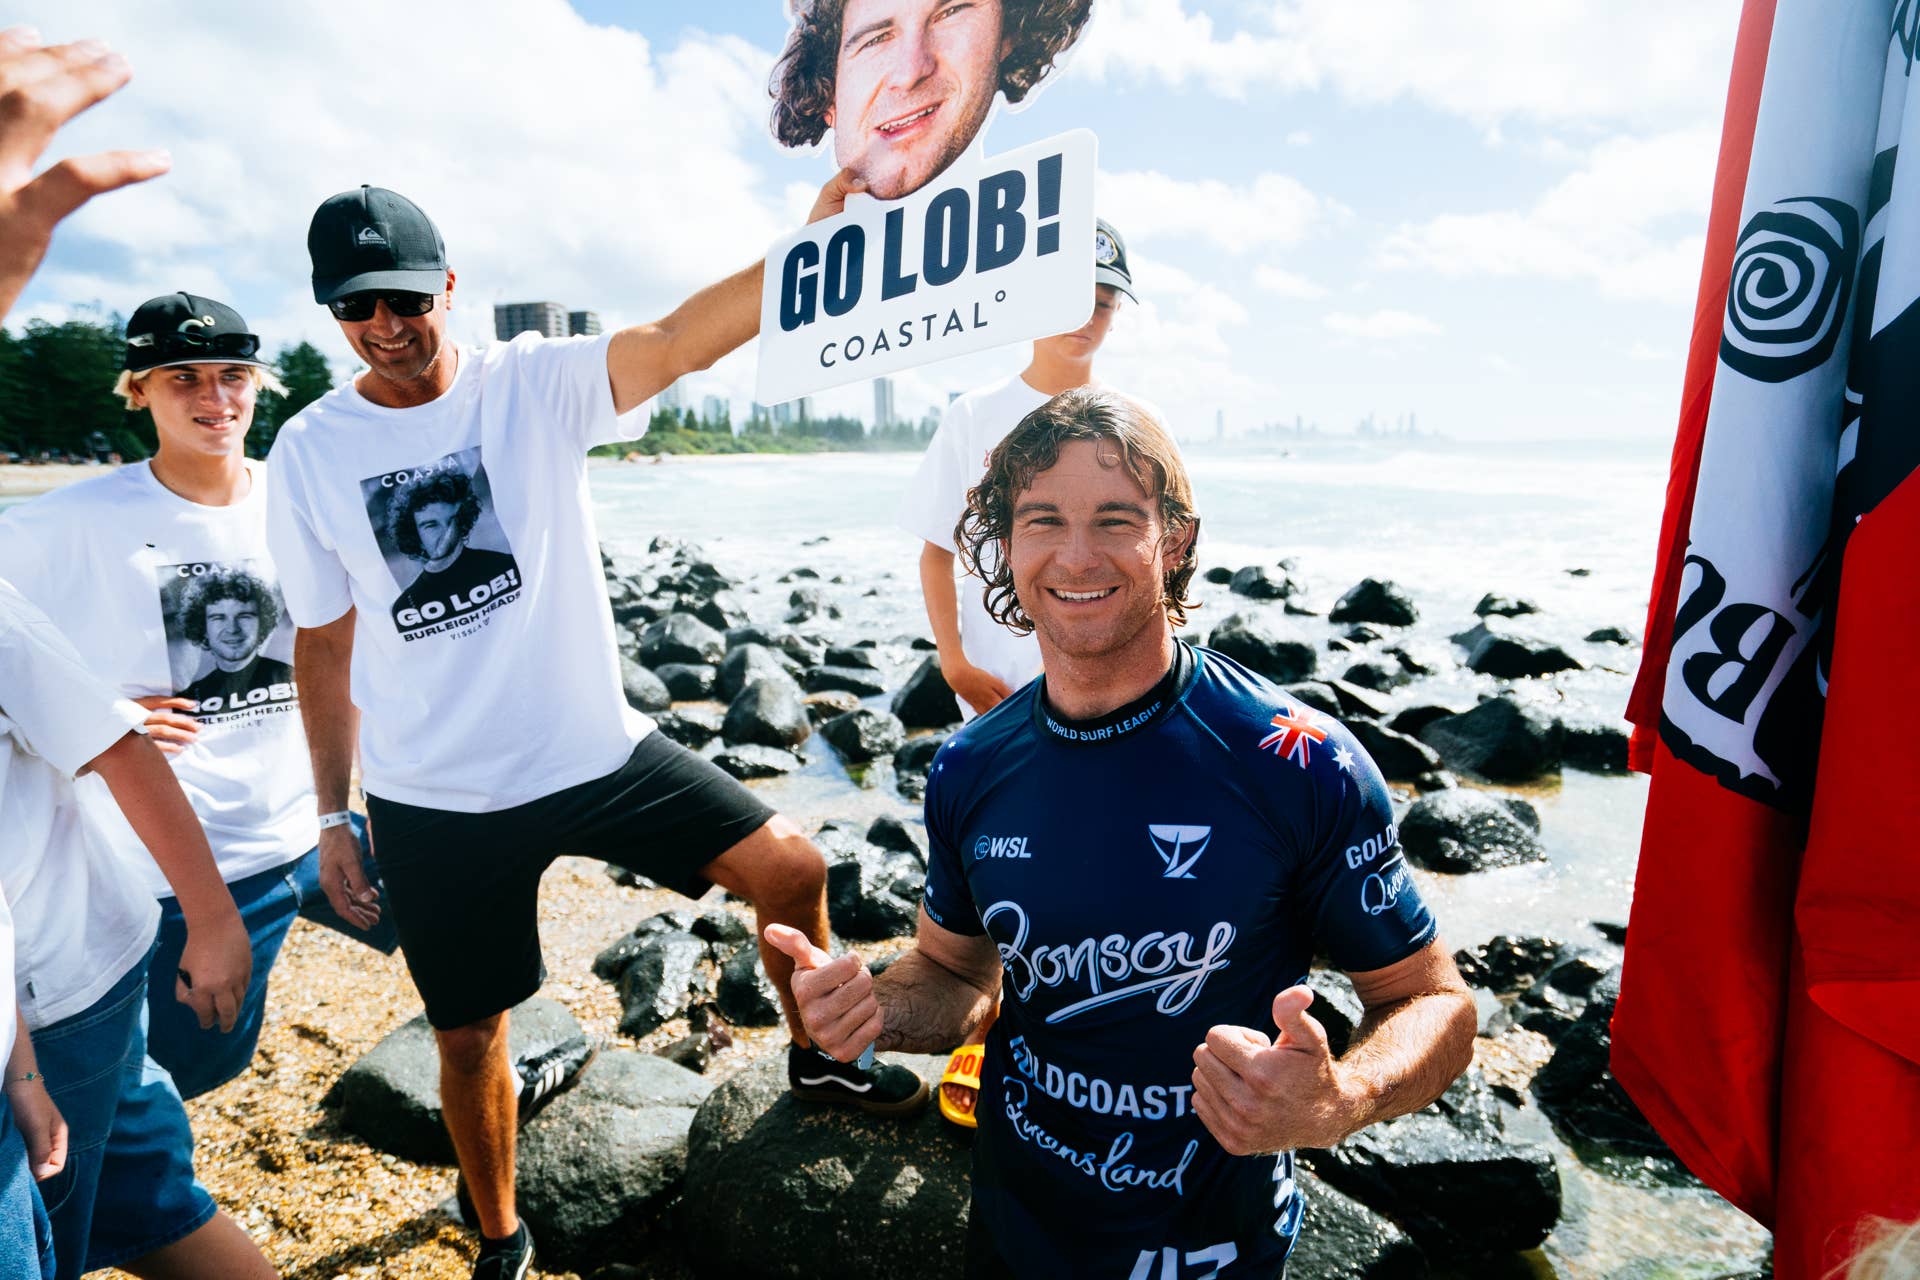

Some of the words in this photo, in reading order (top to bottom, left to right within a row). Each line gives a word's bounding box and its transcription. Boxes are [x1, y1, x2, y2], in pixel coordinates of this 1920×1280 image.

[779, 224, 866, 332] GO
[881, 152, 1063, 302] LOB!
[396, 601, 447, 627] GO
[449, 568, 519, 612] LOB!
[403, 612, 480, 643] BURLEIGH
[482, 590, 521, 616] HEADS
[1046, 716, 1078, 740] WORLD
[1080, 726, 1114, 741] SURF
[1115, 701, 1161, 734] LEAGUE
[990, 836, 1032, 859] WSL
[1003, 1075, 1199, 1196] Queensland
